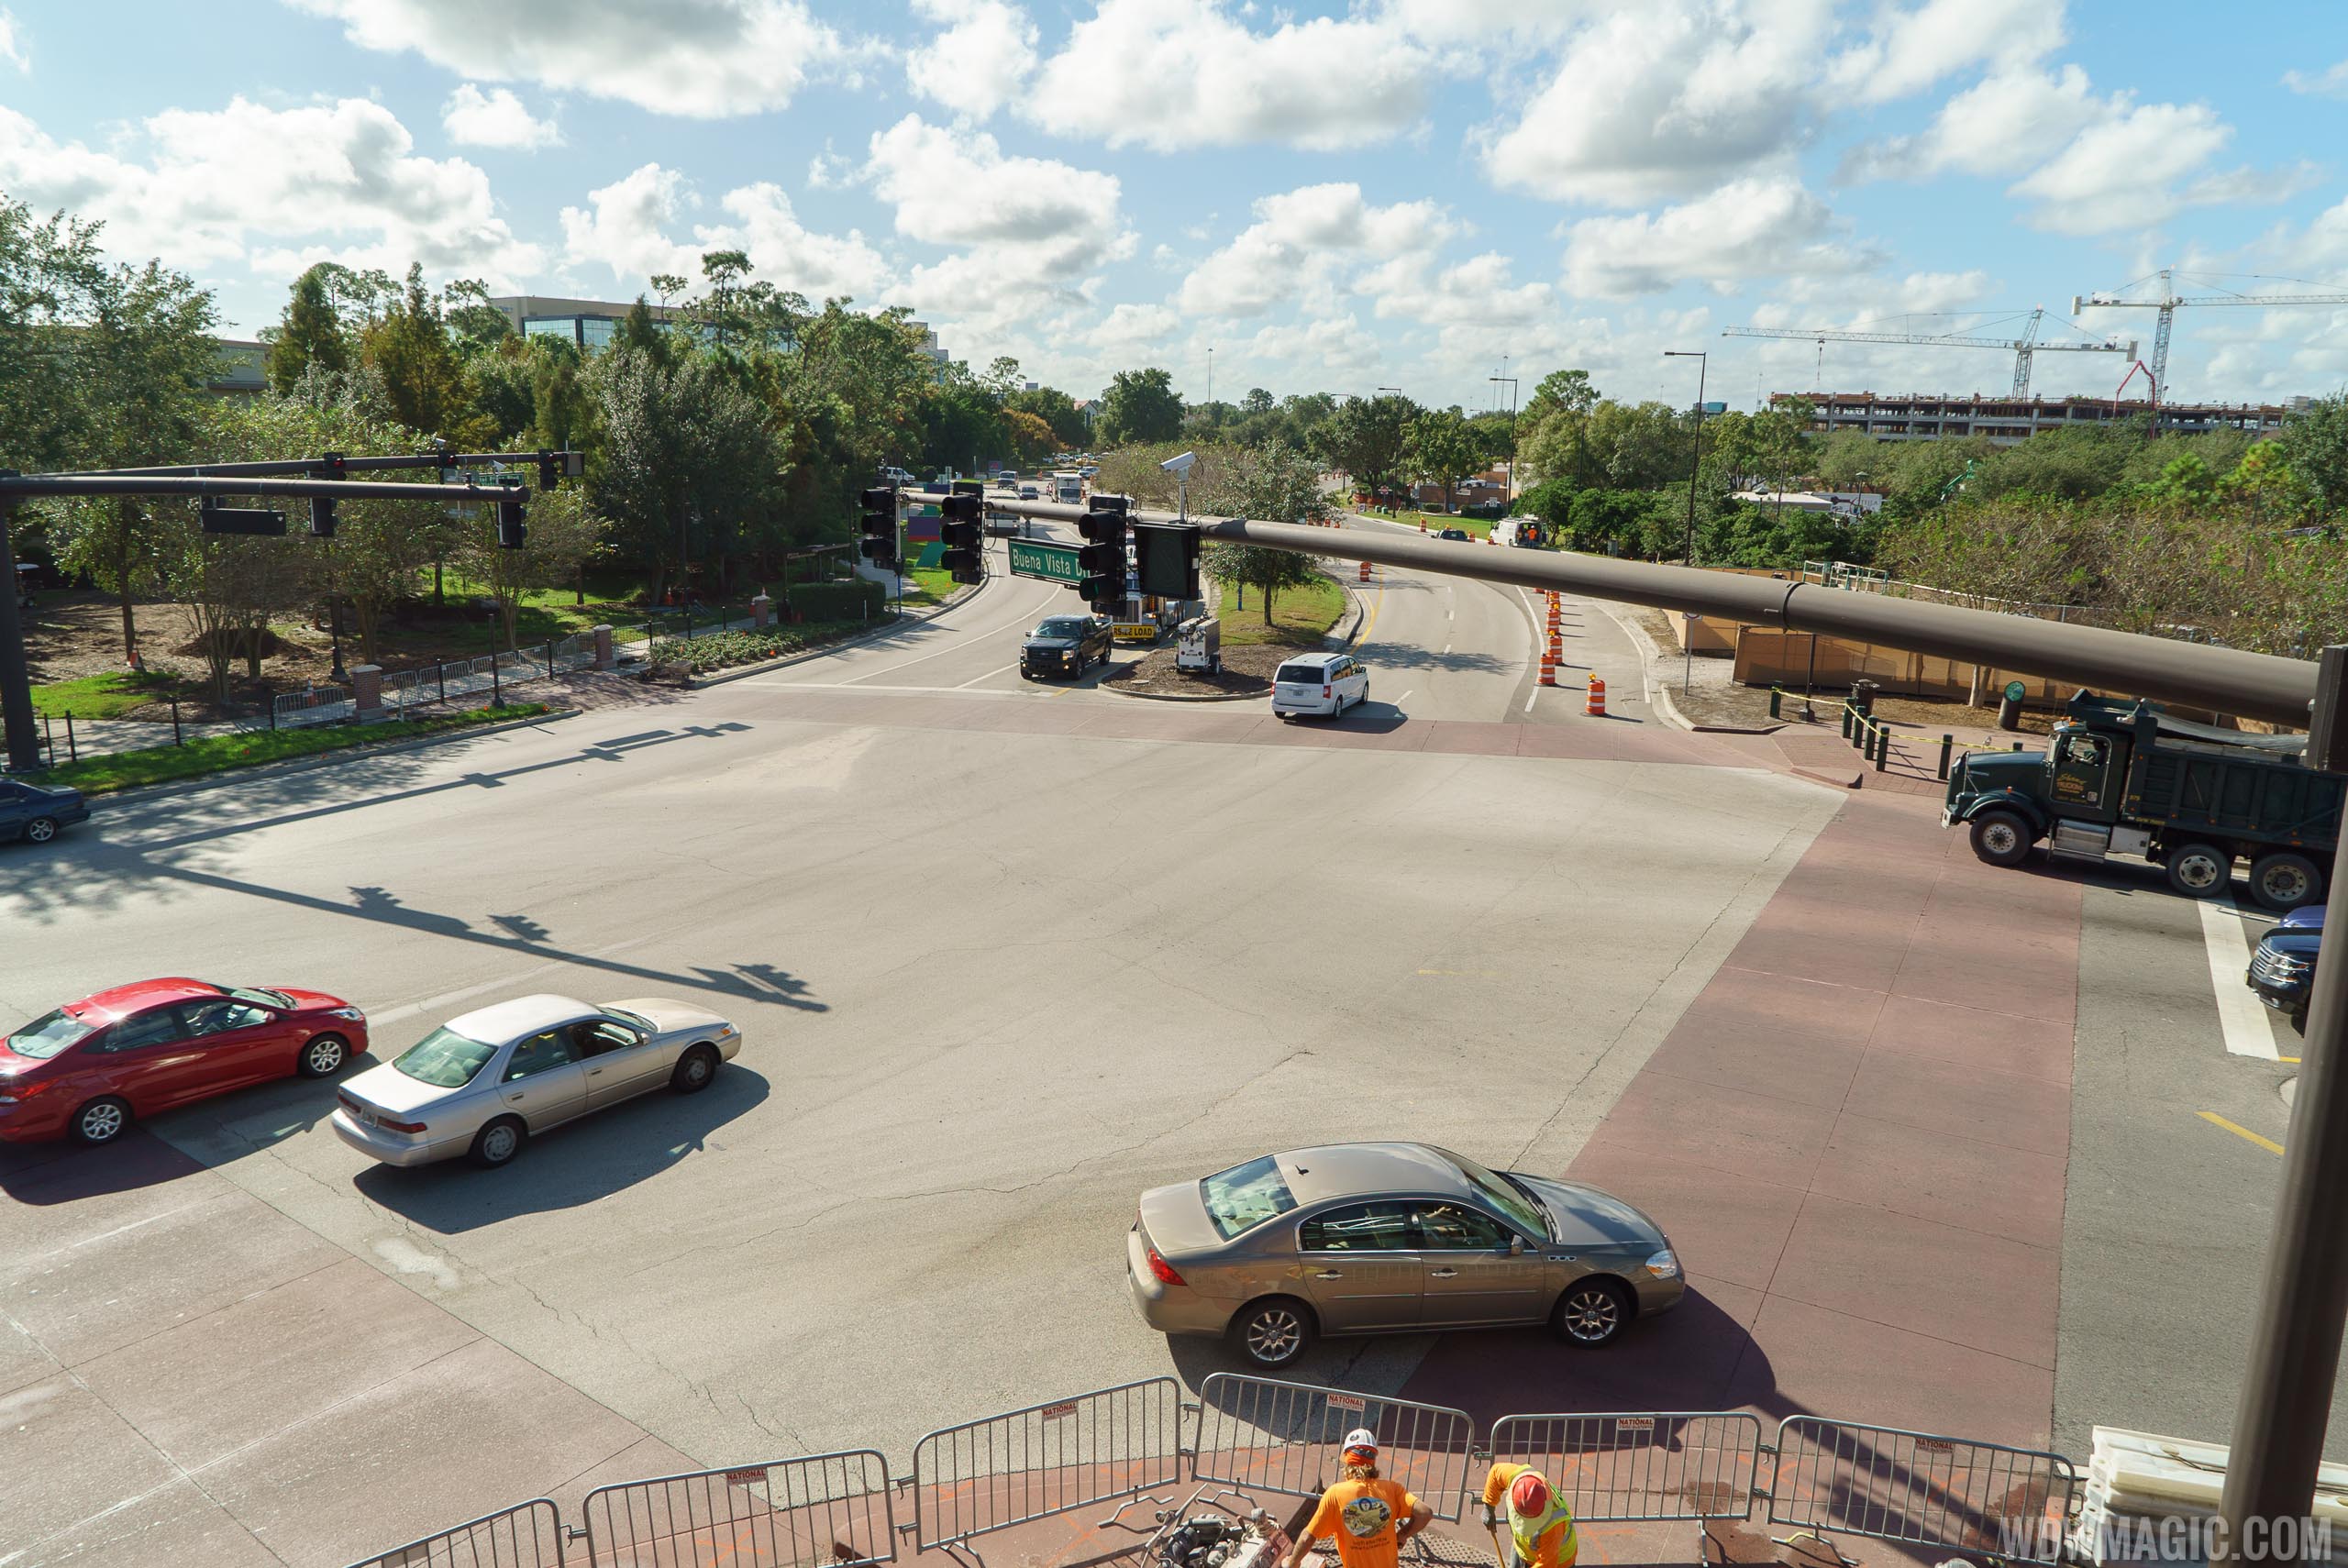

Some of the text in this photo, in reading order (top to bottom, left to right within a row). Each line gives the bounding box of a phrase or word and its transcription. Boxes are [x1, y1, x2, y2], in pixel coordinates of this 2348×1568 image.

[1013, 548, 1041, 569] Buena
[1045, 554, 1070, 575] Vista
[1134, 627, 1153, 636] LOAD
[1328, 1395, 1363, 1407] NATIONAL
[1043, 1402, 1077, 1417] NATIONAL
[1619, 1418, 1653, 1426] NATIONAL
[1916, 1438, 1953, 1450] NATIONAL
[727, 1469, 766, 1480] NATIONAL
